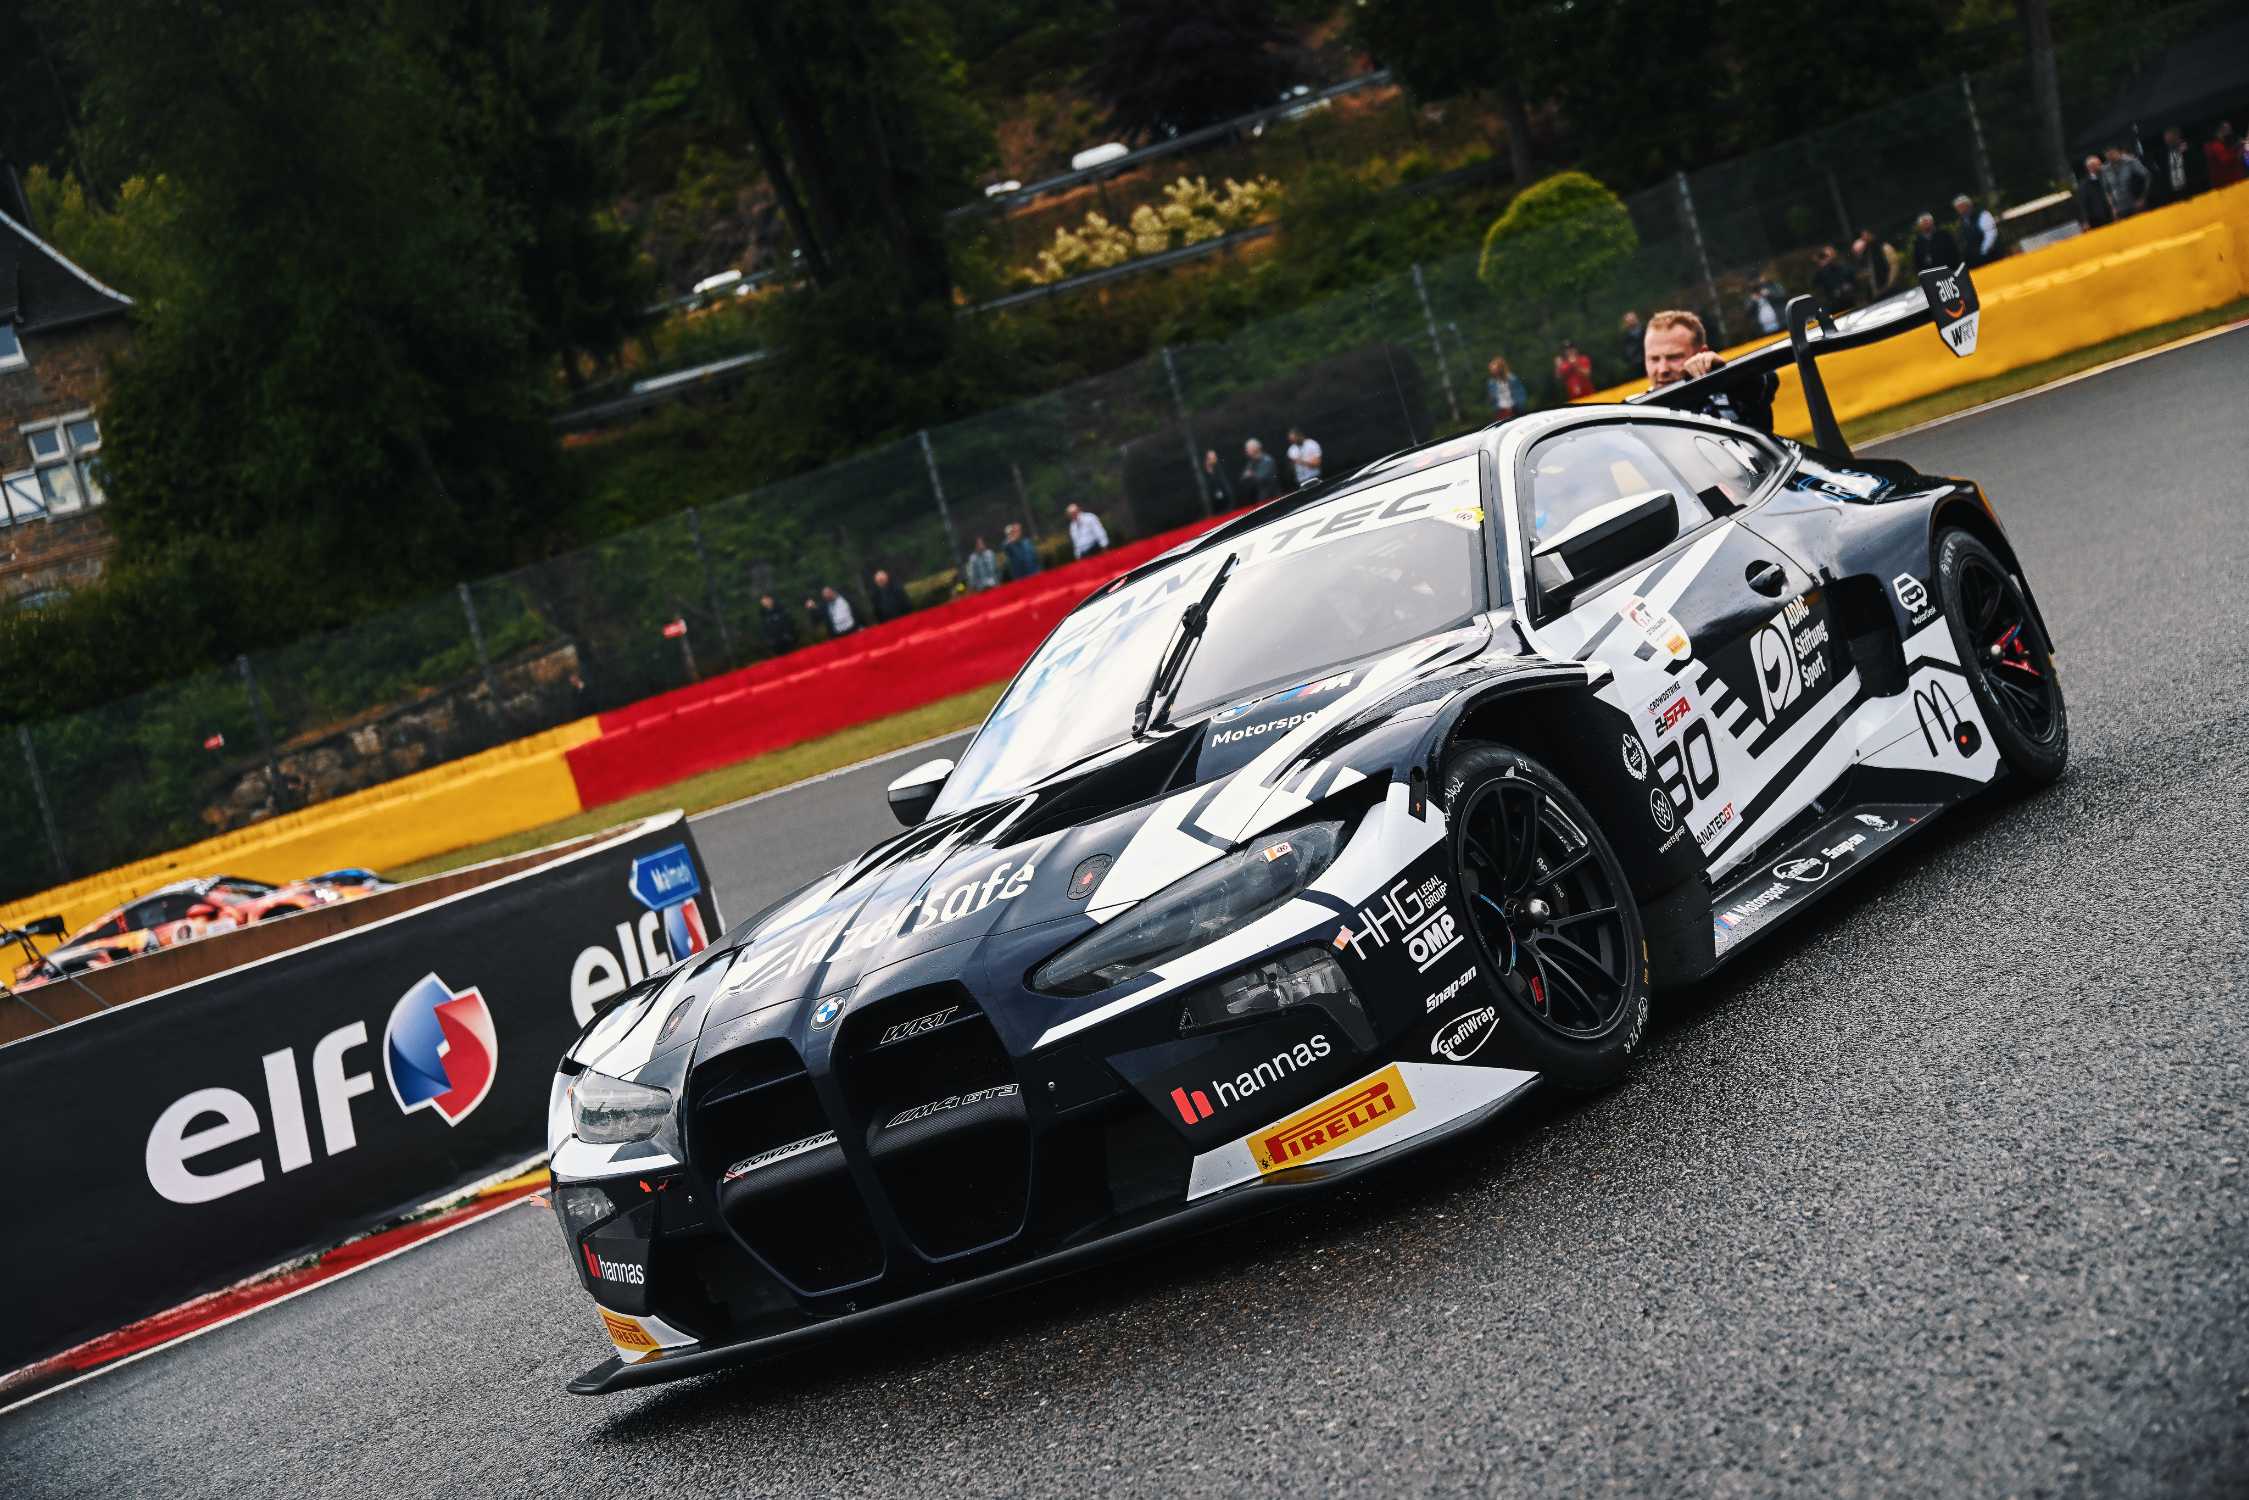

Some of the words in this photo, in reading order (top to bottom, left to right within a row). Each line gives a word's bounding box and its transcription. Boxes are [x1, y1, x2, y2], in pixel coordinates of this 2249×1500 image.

[1936, 276, 1960, 302] aws
[1784, 594, 1809, 630] ADAC
[1794, 619, 1829, 660] Stiftung
[1801, 650, 1826, 687] Sport
[1648, 681, 1681, 713] CROWDSTRIKE
[1212, 711, 1318, 747] Motorspo
[1653, 717, 1719, 818] 30
[1697, 801, 1735, 845] ANATECGT
[1417, 875, 1443, 898] LEGAL
[1350, 878, 1425, 960] HHG
[1408, 914, 1455, 963] OMP
[1426, 966, 1477, 1014] Snap-on
[880, 1005, 958, 1044] WRT
[1438, 1006, 1496, 1055] GrafiWrap
[1212, 1034, 1331, 1107] hannas
[145, 1020, 374, 1204] elf
[962, 1083, 1019, 1105] GT3
[1265, 1081, 1396, 1164] PIRELLI
[598, 1254, 644, 1285] hannas
